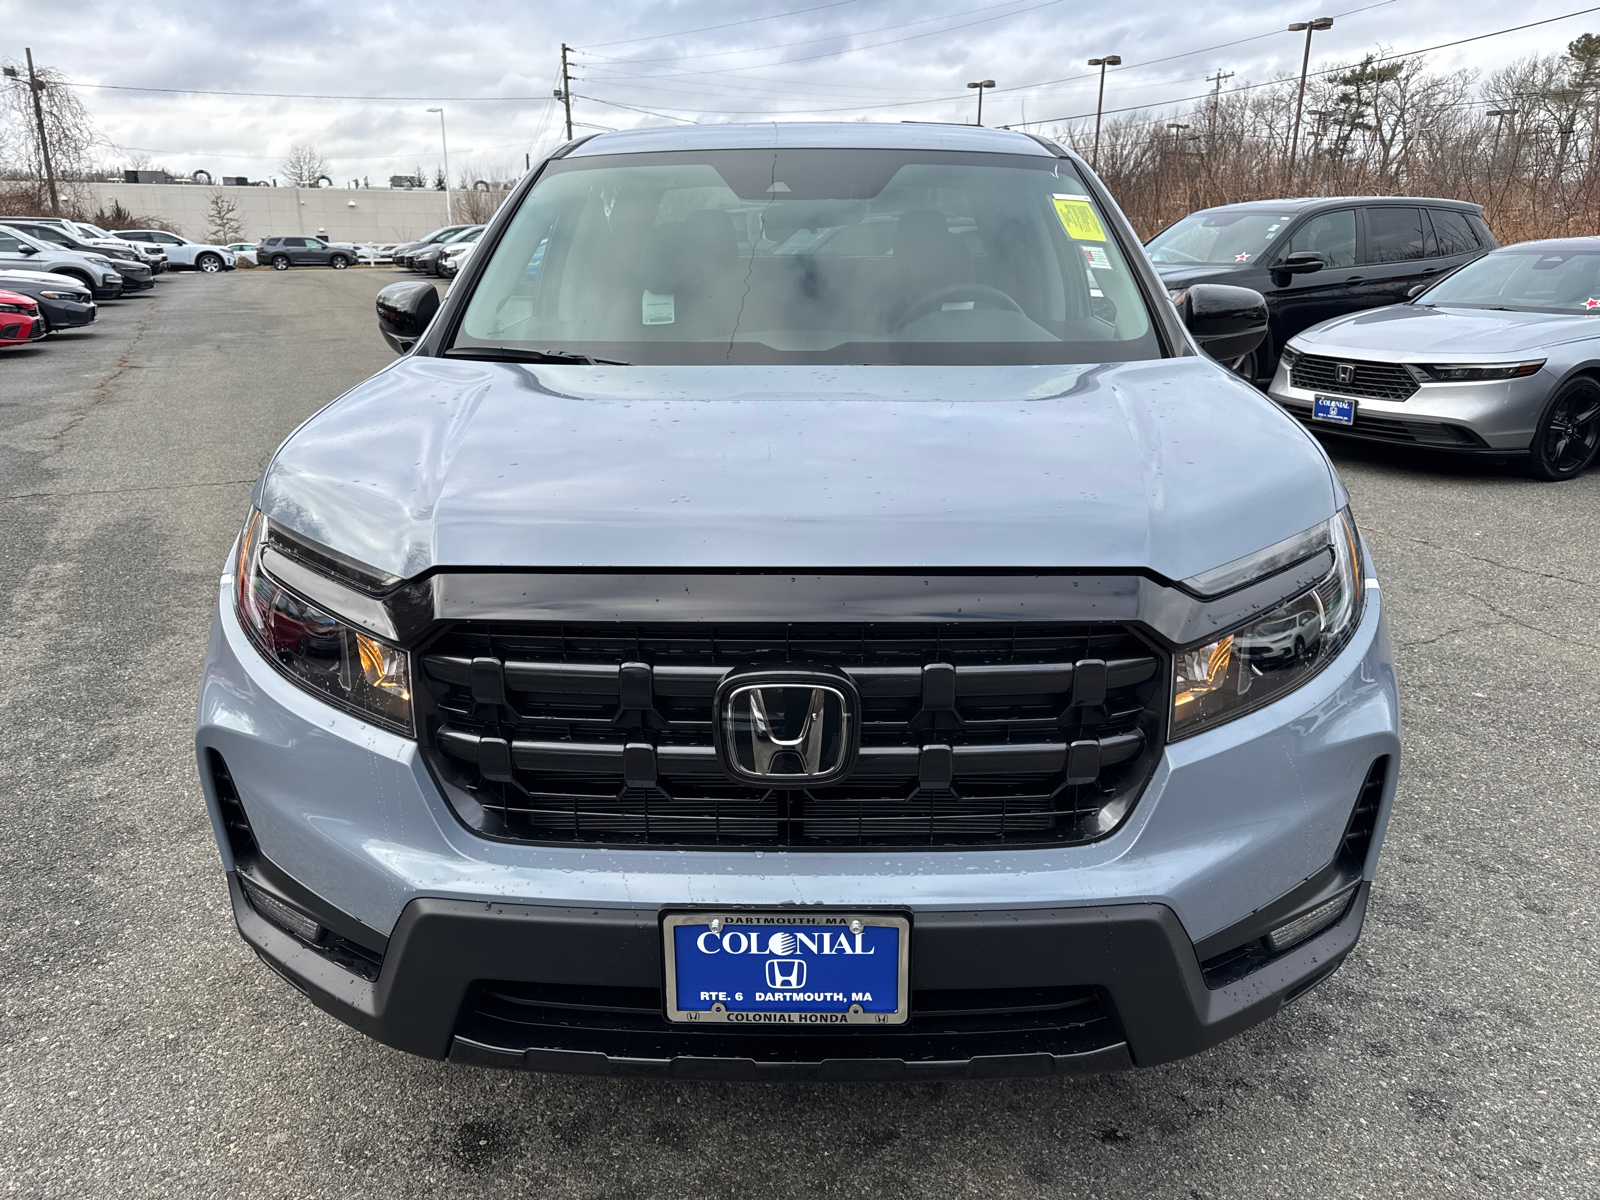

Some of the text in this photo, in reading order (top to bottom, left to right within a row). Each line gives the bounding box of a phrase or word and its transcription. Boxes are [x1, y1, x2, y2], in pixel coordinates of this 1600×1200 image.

[1319, 399, 1350, 409] COLONIAL
[825, 917, 848, 925] MA
[696, 932, 875, 956] COLONIAL
[700, 992, 873, 1003] RTE. 6 DARTMOUTH, MA
[726, 1013, 848, 1023] COLONIAL HONDA
